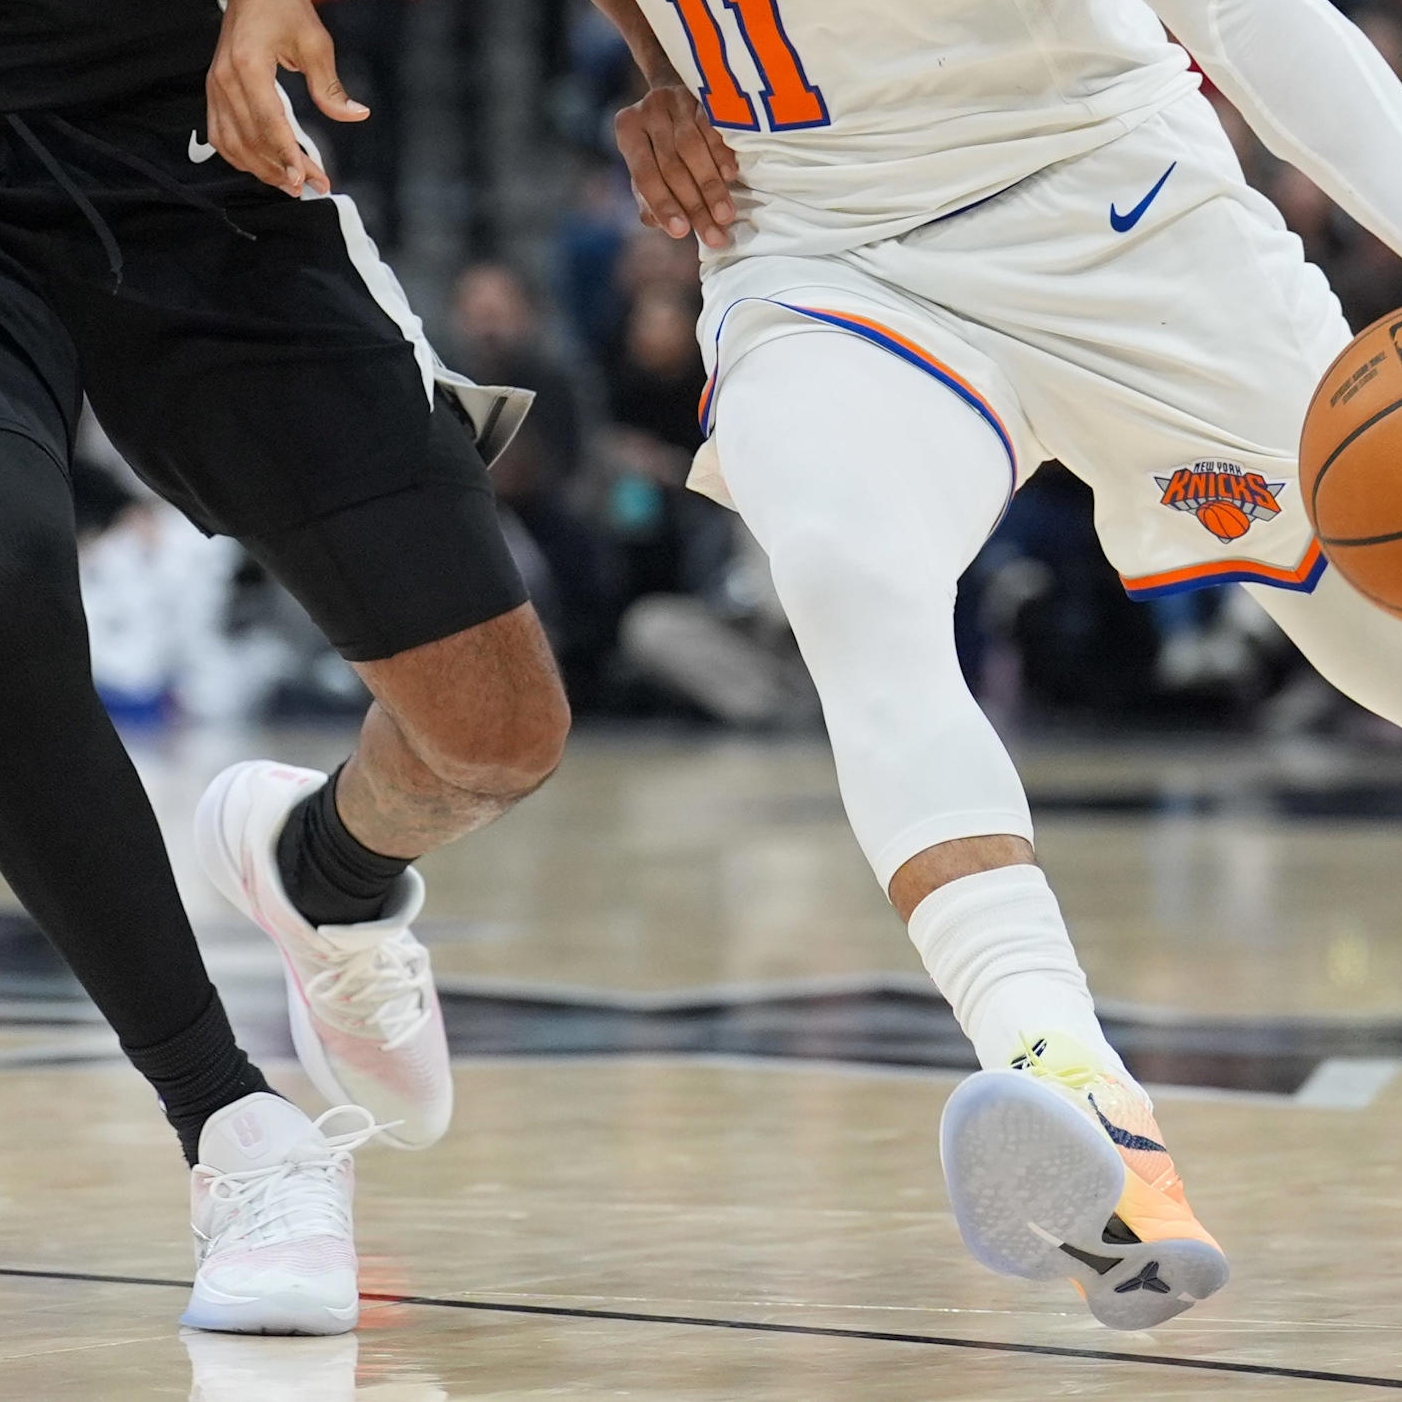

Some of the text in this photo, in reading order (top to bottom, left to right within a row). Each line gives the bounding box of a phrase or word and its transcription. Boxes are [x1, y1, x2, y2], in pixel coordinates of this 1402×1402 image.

[1193, 461, 1242, 475] NEW YORK
[1160, 468, 1282, 514] KNICKS
